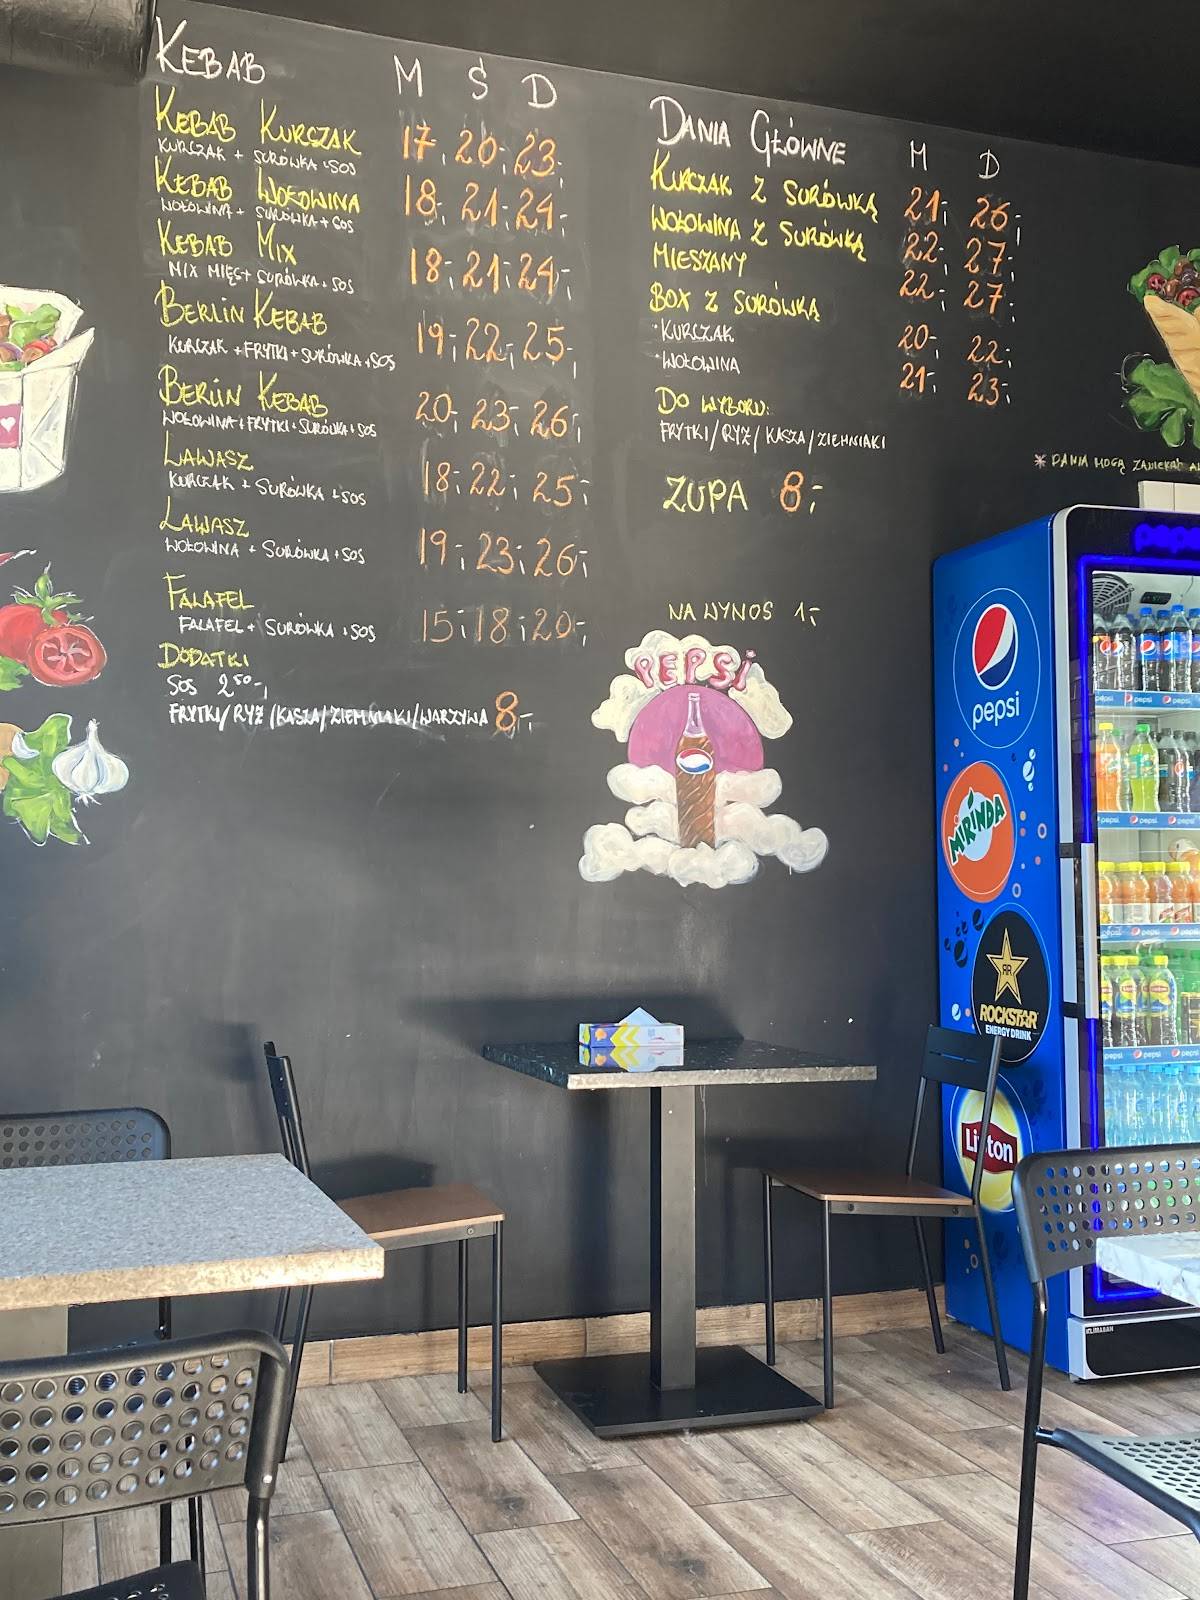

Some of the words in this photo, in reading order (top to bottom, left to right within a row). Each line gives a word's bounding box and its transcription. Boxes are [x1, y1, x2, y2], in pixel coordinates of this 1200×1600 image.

[155, 16, 265, 84] KEBAB
[394, 54, 423, 97] M
[521, 73, 558, 109] D
[156, 85, 236, 142] KEBAB
[261, 98, 362, 155] KURCZAK
[650, 95, 731, 148] DANIA
[750, 109, 846, 168] GŁÓWNE
[158, 138, 225, 161] KURCZAK
[979, 149, 1000, 179] D
[155, 155, 232, 201] KEBAB
[651, 148, 732, 196] KURCZAK
[751, 174, 767, 204] Z
[157, 218, 233, 257] KEBAB
[257, 221, 297, 265] MIX
[651, 203, 742, 242] WOŁOWINA
[751, 218, 768, 247] Z
[169, 261, 198, 279] MIX
[652, 242, 748, 278] MIESZANY
[254, 288, 327, 335] KEBAB
[649, 281, 691, 313] BOX
[705, 290, 719, 313] Z
[257, 370, 328, 417] KEBAB
[164, 430, 254, 471] LAWASZ
[662, 475, 749, 514] ZUPA
[160, 495, 249, 538] LAWASZ
[162, 572, 254, 611] FALAFEL
[179, 614, 244, 634] FALAFEL
[668, 602, 696, 621] NA
[704, 601, 773, 622] WYNOS
[157, 642, 249, 669] DODATKI
[972, 691, 1020, 730] pepsi
[948, 794, 1006, 866] MIRINDA
[980, 1003, 1038, 1030] ROCKSTAR
[985, 1024, 1011, 1038] ENERGY
[1010, 1028, 1032, 1041] DRINK
[965, 1128, 1013, 1164] Liton
